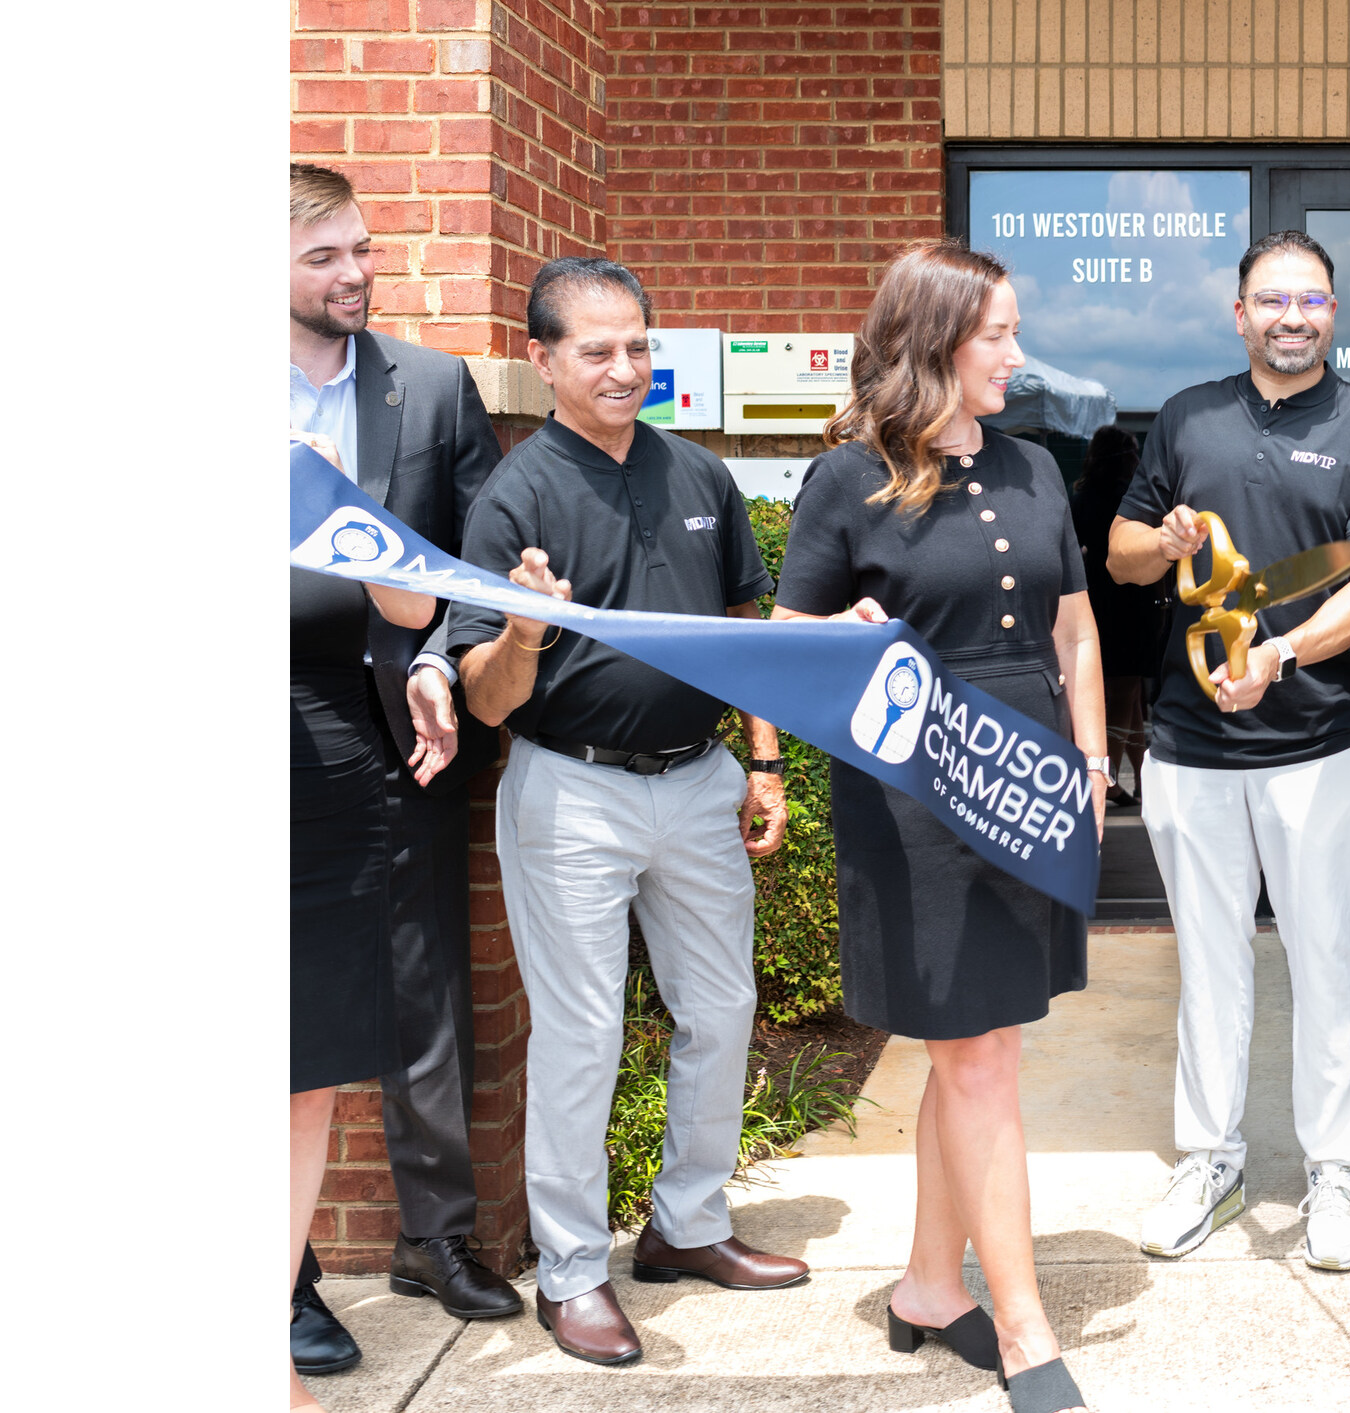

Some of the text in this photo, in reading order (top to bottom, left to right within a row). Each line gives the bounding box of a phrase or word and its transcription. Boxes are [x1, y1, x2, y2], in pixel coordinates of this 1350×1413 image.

[992, 213, 1226, 237] 101 WESTOVER CIRCLE
[1072, 258, 1153, 283] SUITE B
[1290, 450, 1337, 470] MDVIP
[683, 516, 716, 531] MDVIP
[930, 677, 1093, 815] MADISON
[924, 723, 1076, 853] CHAMBER
[933, 777, 1035, 861] OF COMMERCE
